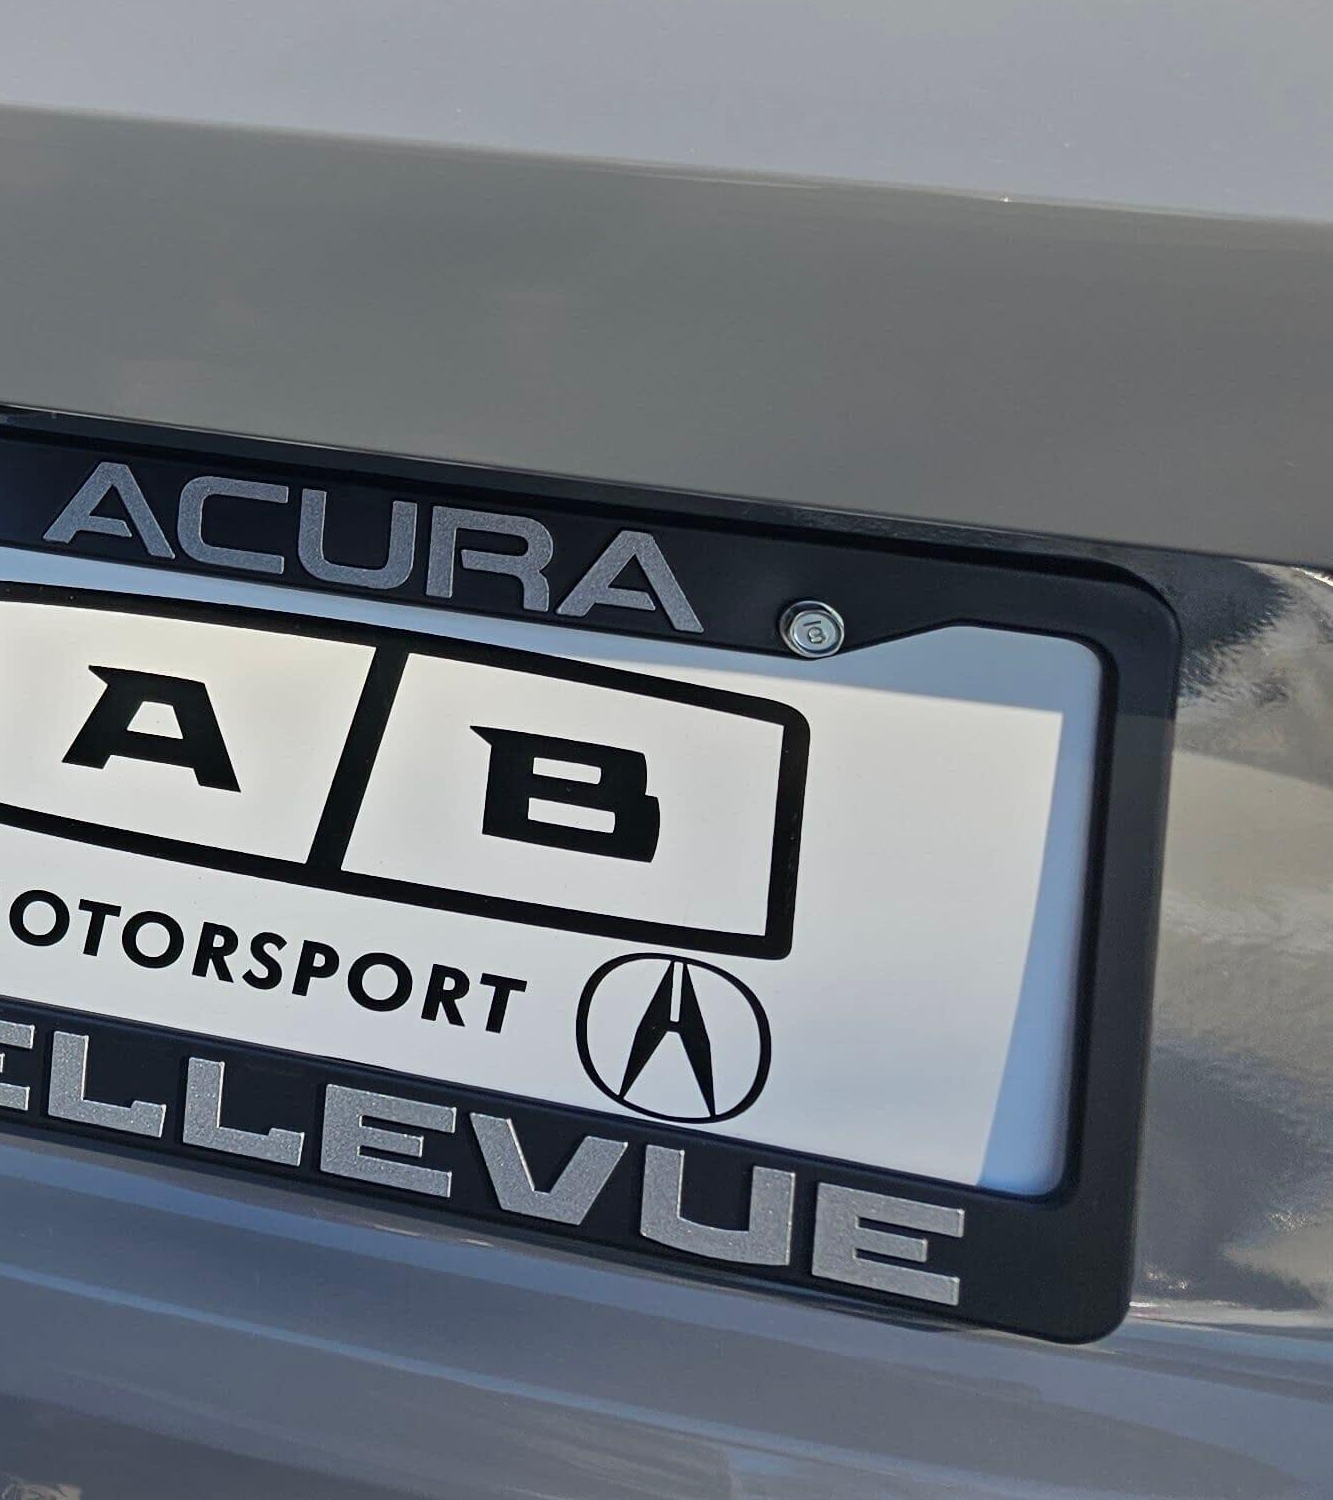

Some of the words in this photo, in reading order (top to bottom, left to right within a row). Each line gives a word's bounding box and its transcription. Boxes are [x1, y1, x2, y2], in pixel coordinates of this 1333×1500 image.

[42, 460, 706, 634] ACURA
[61, 664, 242, 793] A
[468, 724, 662, 863] B
